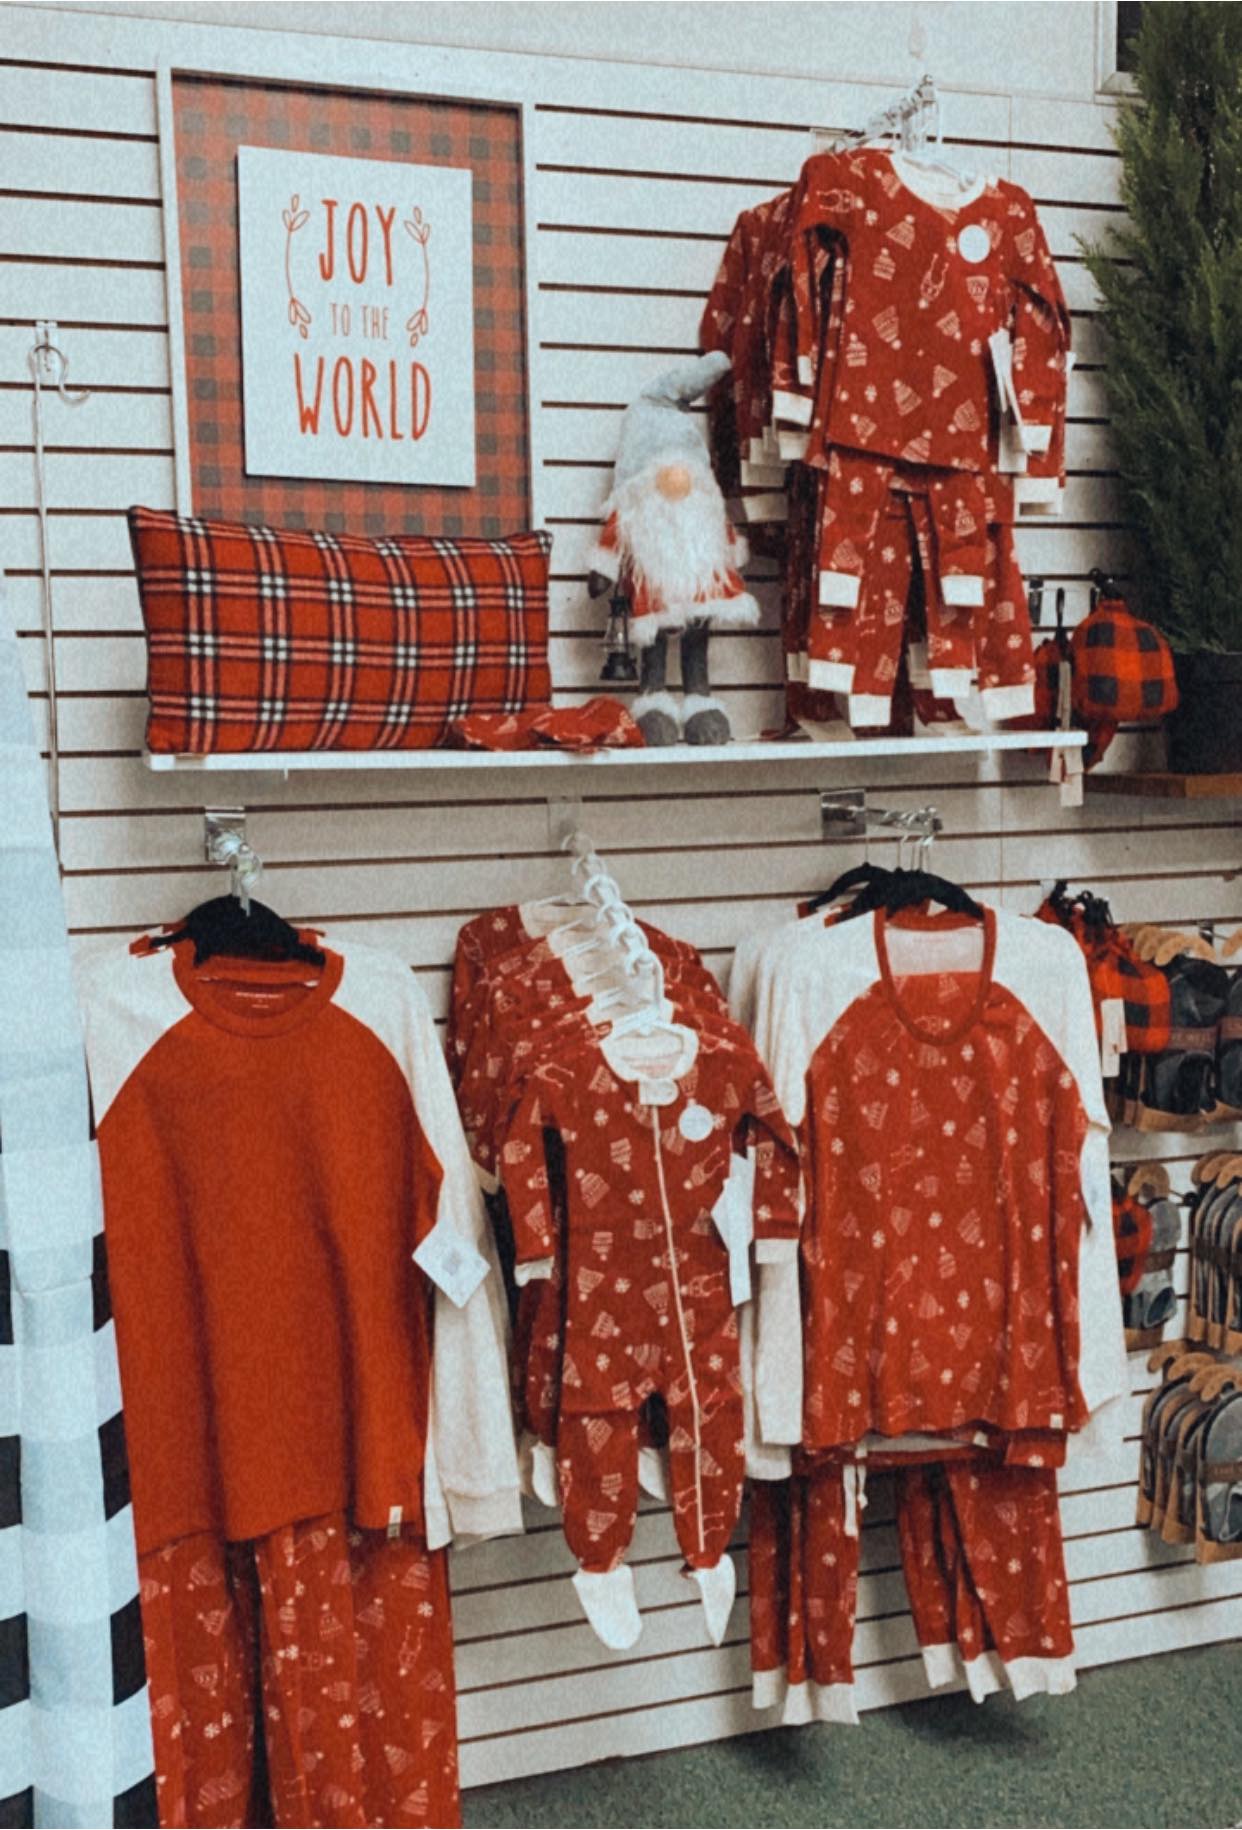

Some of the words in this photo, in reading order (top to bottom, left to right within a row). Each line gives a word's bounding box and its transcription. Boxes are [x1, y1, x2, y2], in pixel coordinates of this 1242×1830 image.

[319, 199, 396, 287] JOY
[330, 303, 351, 337] TO
[361, 305, 390, 341] THE
[295, 353, 431, 441] WORLD
